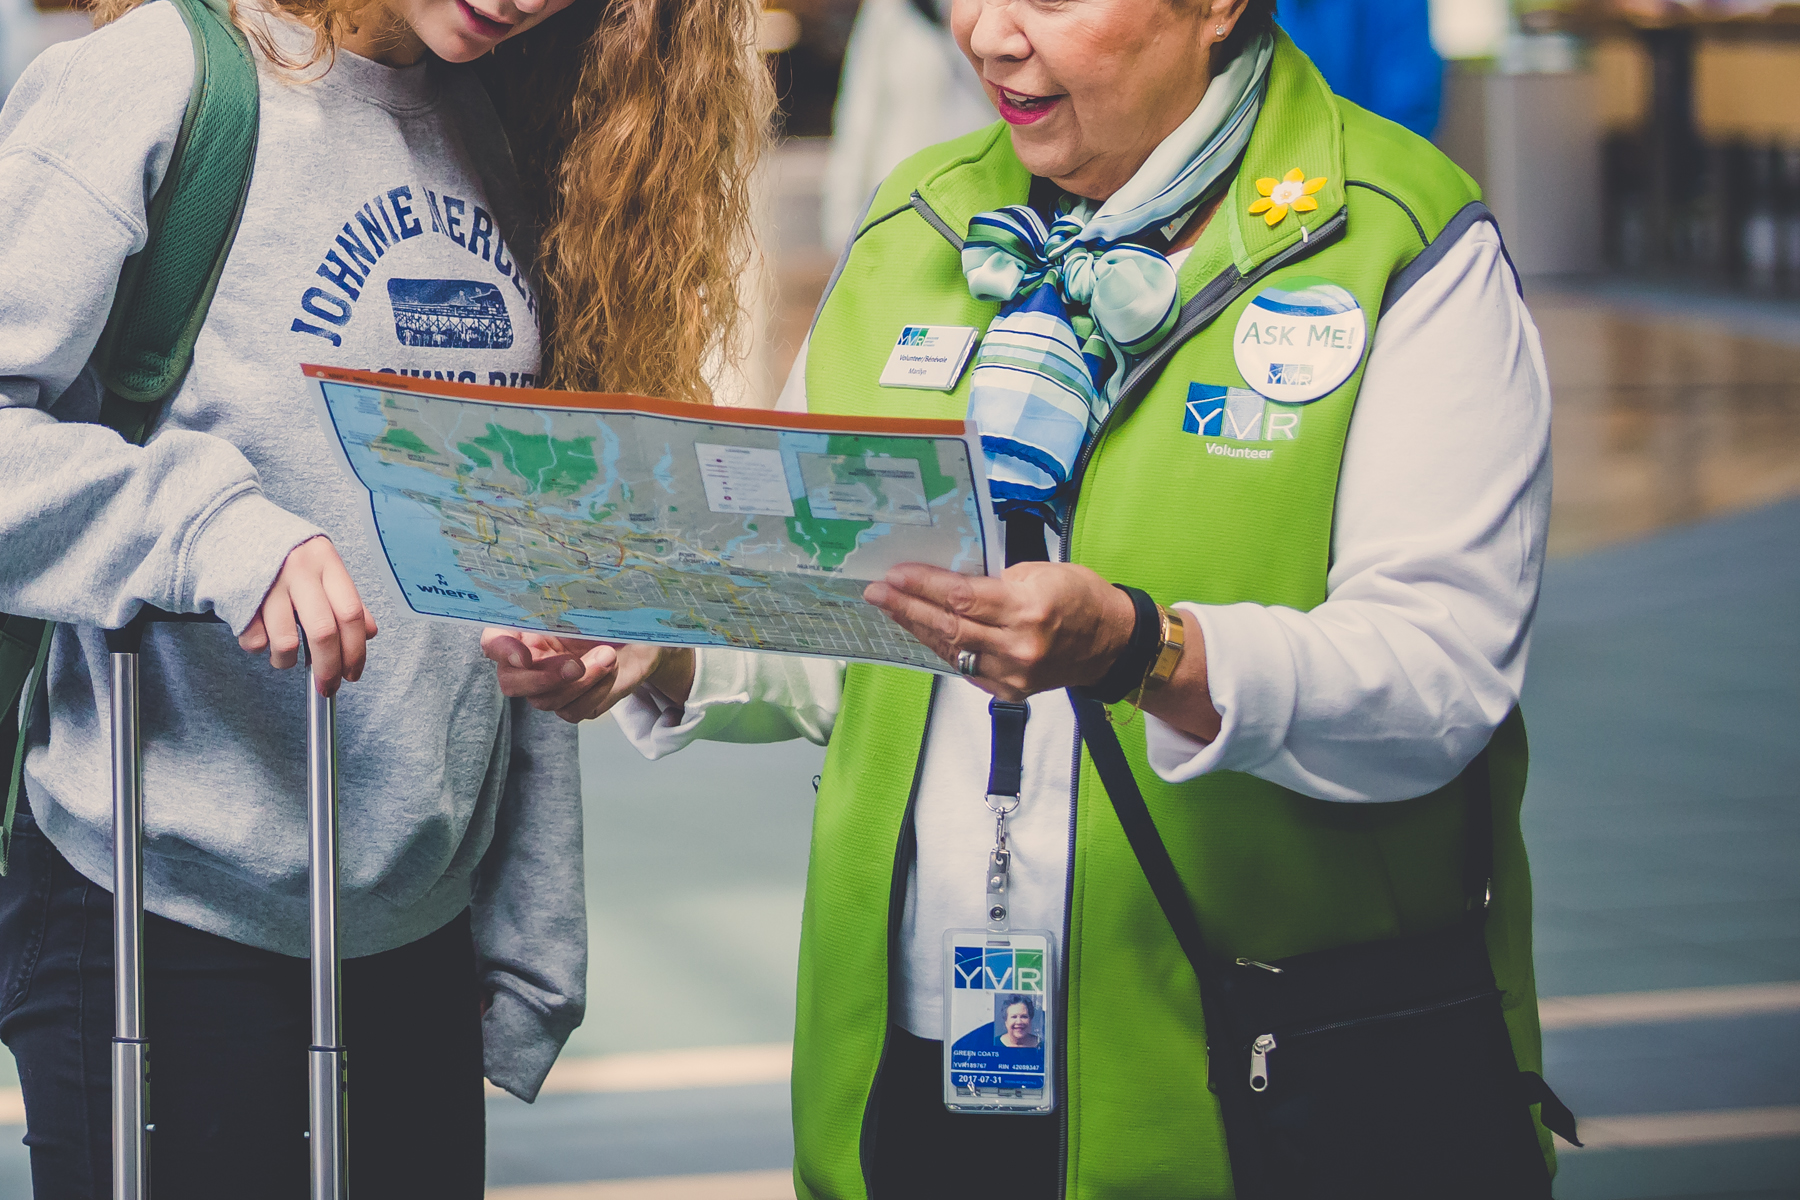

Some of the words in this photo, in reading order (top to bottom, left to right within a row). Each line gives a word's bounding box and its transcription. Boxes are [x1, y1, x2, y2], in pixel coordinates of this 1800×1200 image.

[291, 185, 423, 347] JOHNNIE
[897, 332, 926, 346] YVR
[1241, 321, 1296, 346] ASK
[1307, 324, 1355, 349] ME!
[1267, 368, 1314, 386] YVR
[1184, 398, 1299, 441] YVR
[1205, 443, 1274, 459] Volunteer
[415, 584, 480, 602] where
[955, 959, 1042, 992] YVR
[958, 1074, 1002, 1084] 2017-07-31
